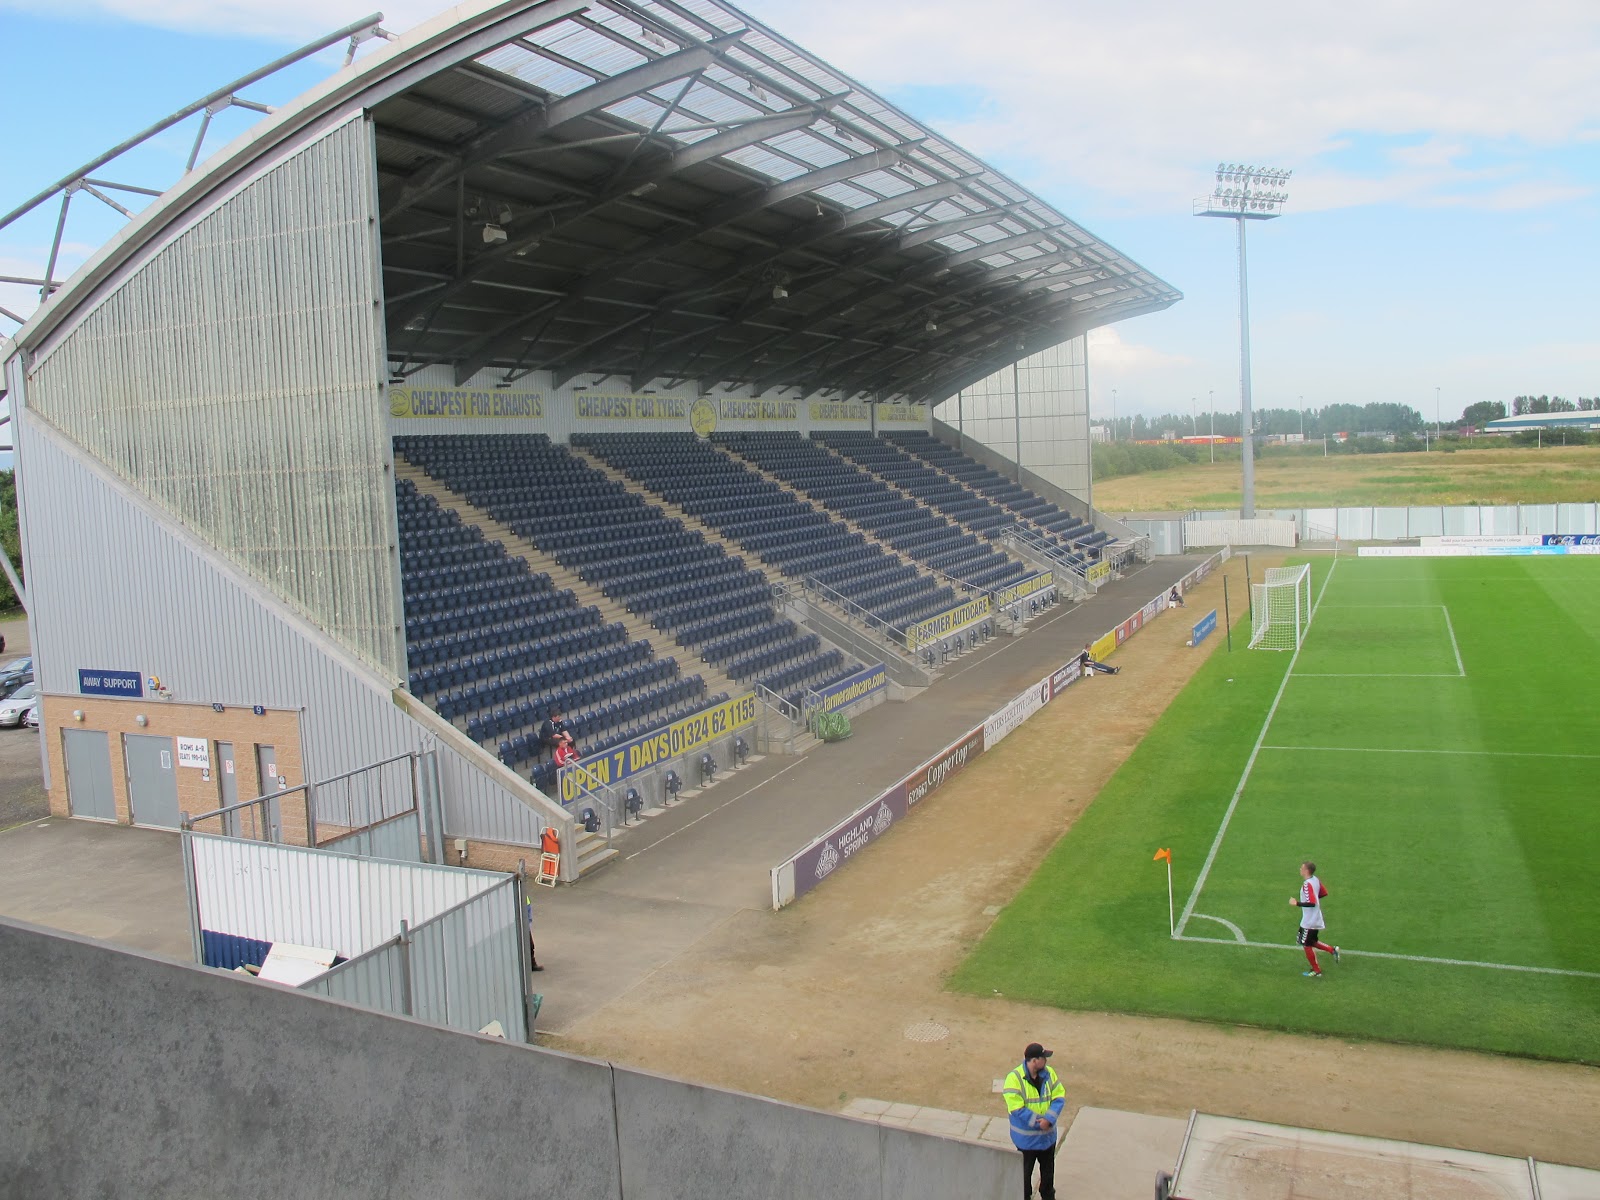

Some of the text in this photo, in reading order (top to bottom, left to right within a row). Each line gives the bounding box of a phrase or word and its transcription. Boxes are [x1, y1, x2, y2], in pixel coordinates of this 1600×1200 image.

[411, 390, 467, 416] CHEAPEST
[470, 392, 491, 416] FOR
[493, 393, 542, 416] EXHAUSTS
[578, 396, 633, 418] CHEAPEST
[636, 398, 654, 418] FOR
[657, 399, 685, 418] TYRES
[722, 400, 760, 419] CHEAPEST
[762, 401, 776, 419] FOR
[778, 402, 797, 419] MOTS
[917, 599, 988, 641] FARMER AUTOCARE
[83, 676, 137, 689] AWAY SUPPORT
[805, 671, 885, 720] .farmerautocare.com
[256, 706, 262, 714] 9
[671, 698, 755, 753] 01324 62 1155
[562, 732, 670, 801] OPEN 7 DAYS
[927, 744, 968, 788] Coppertop
[838, 815, 873, 850] HIGHLAND
[844, 831, 869, 858] SPRING
